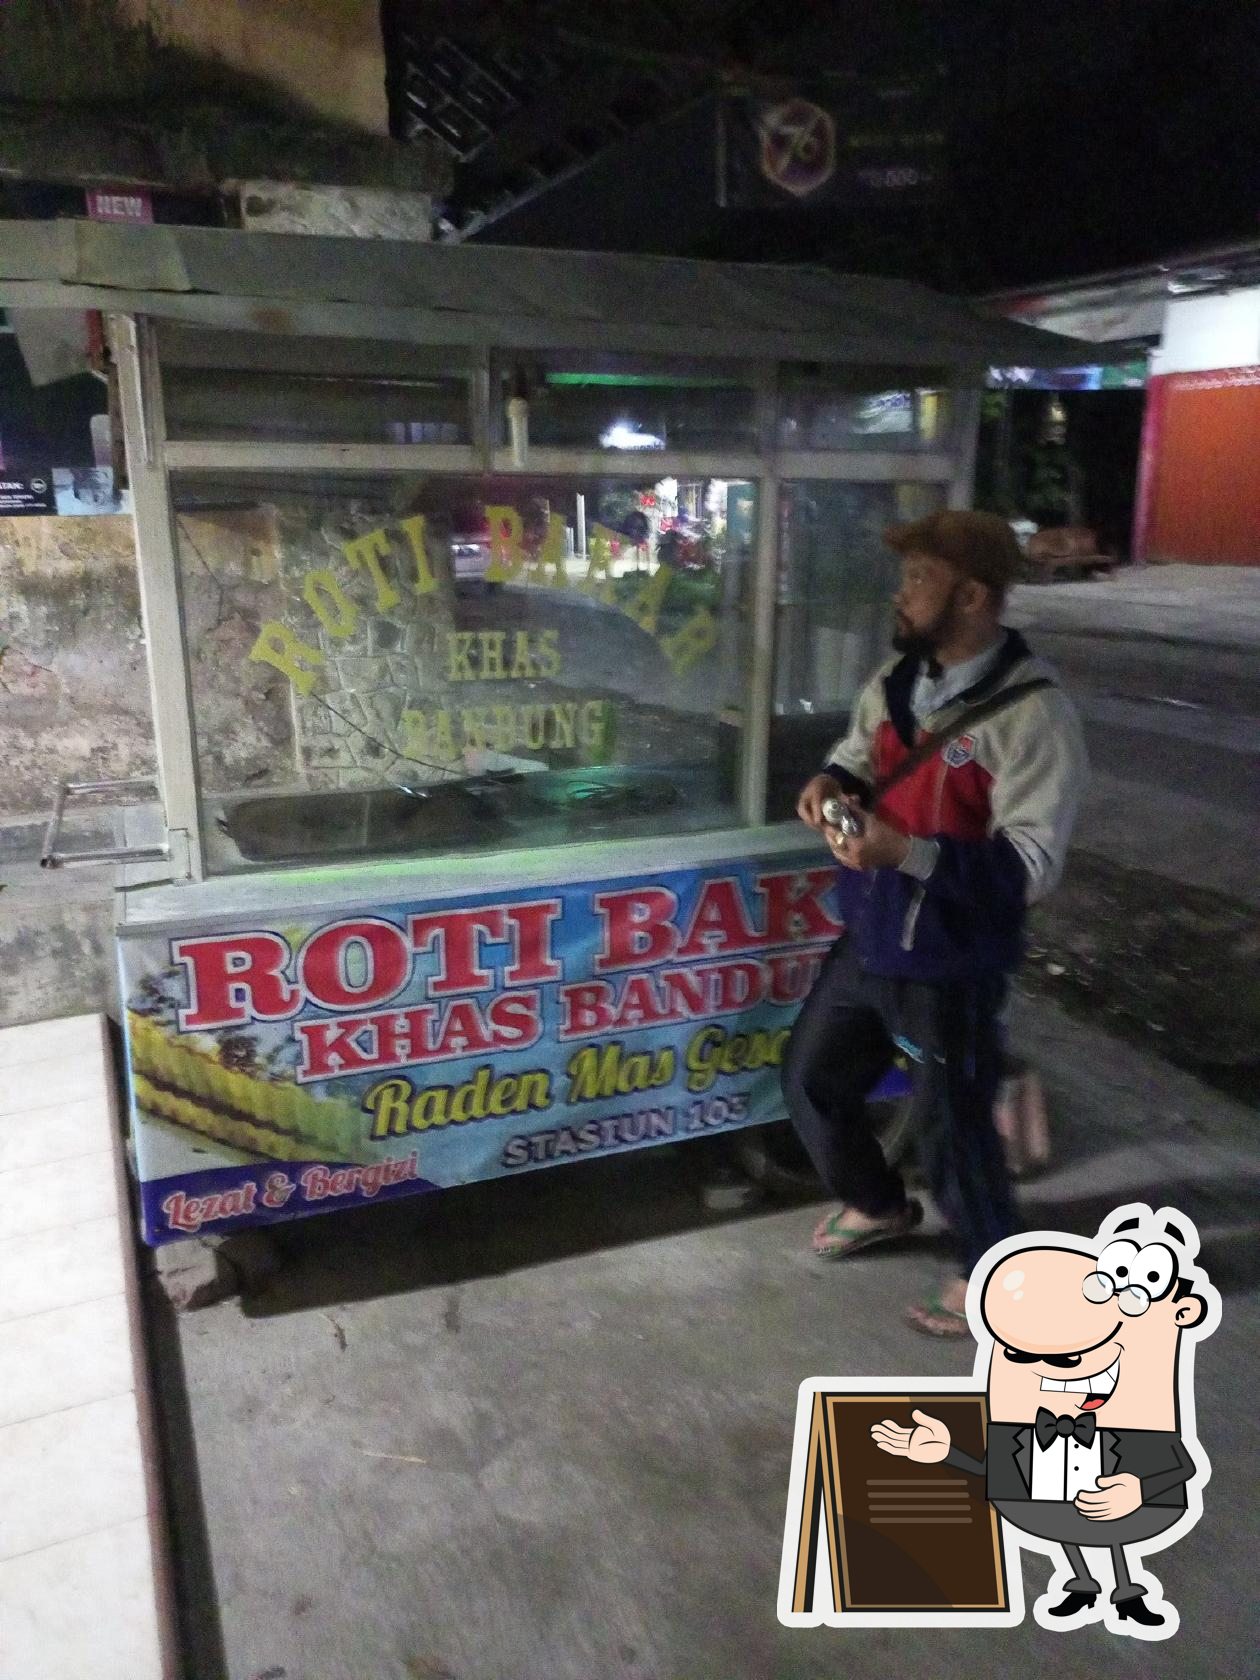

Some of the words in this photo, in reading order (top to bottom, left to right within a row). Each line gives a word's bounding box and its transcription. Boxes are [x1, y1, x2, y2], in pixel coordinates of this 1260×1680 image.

[96, 195, 143, 217] NEW
[249, 515, 438, 697] ROTI
[446, 629, 562, 682] KHAS
[171, 898, 563, 1032] ROTI
[594, 866, 846, 974] BAK
[294, 989, 543, 1083] KHAS
[559, 946, 832, 1042] BANDU
[364, 1065, 552, 1140] Raden
[567, 1039, 675, 1103] Mas
[504, 1106, 676, 1167] STASIUN
[163, 1181, 257, 1232] Lezat
[263, 1172, 297, 1207] &
[301, 1150, 418, 1198] Bergizi
